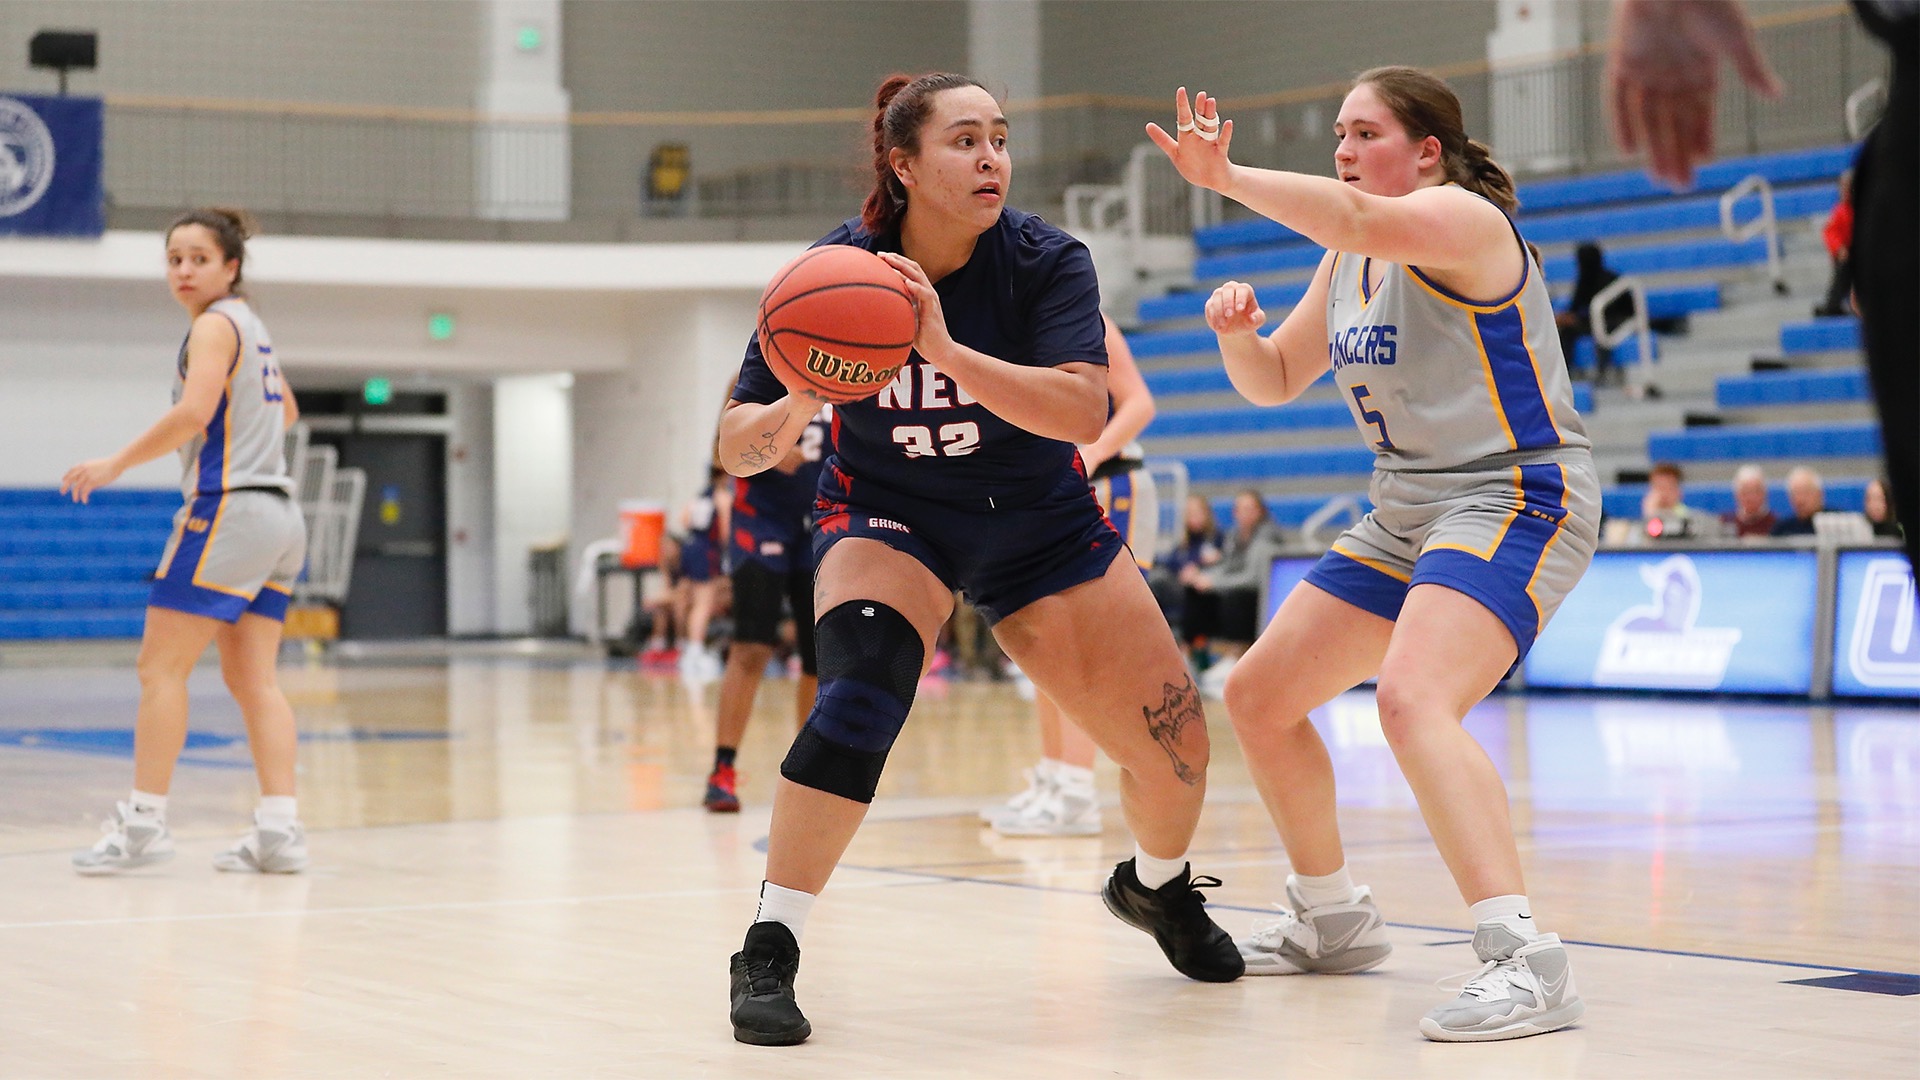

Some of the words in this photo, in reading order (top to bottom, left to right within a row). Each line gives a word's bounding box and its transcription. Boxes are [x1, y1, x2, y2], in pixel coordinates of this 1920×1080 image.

[807, 346, 902, 385] Wilson
[1329, 325, 1397, 374] ANCERS
[1350, 383, 1395, 449] 5
[892, 421, 980, 458] 32
